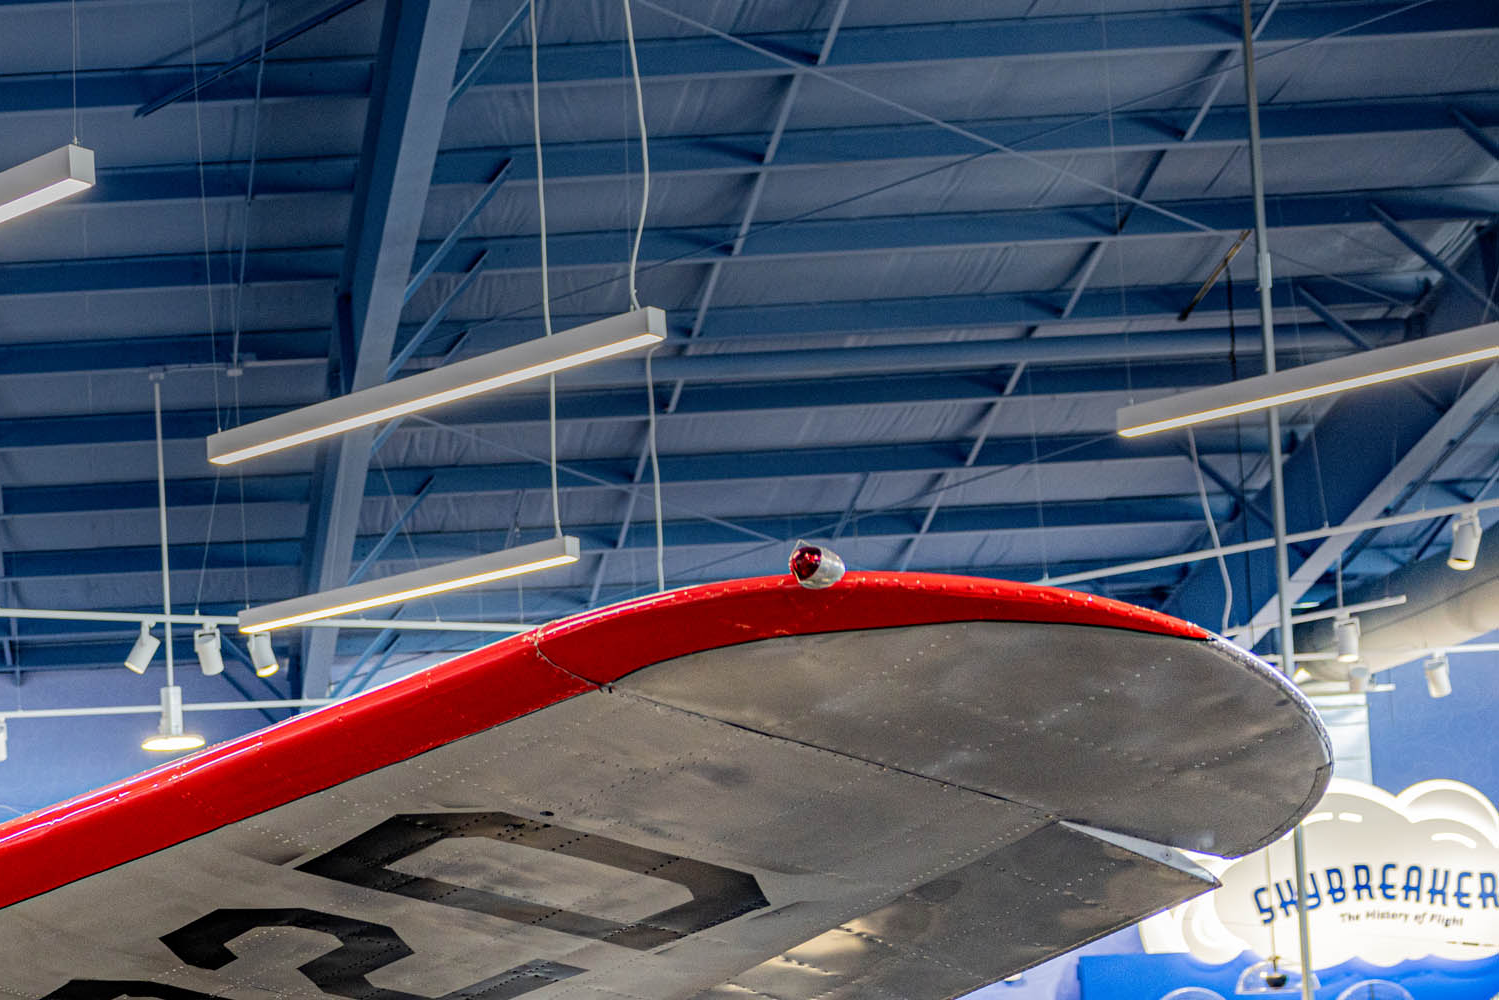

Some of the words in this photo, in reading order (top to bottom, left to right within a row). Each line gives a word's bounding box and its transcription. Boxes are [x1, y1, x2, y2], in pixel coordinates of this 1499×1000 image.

[1340, 912, 1361, 923] The
[1365, 910, 1409, 923] History
[1413, 911, 1427, 925] of
[1428, 913, 1464, 927] Flight
